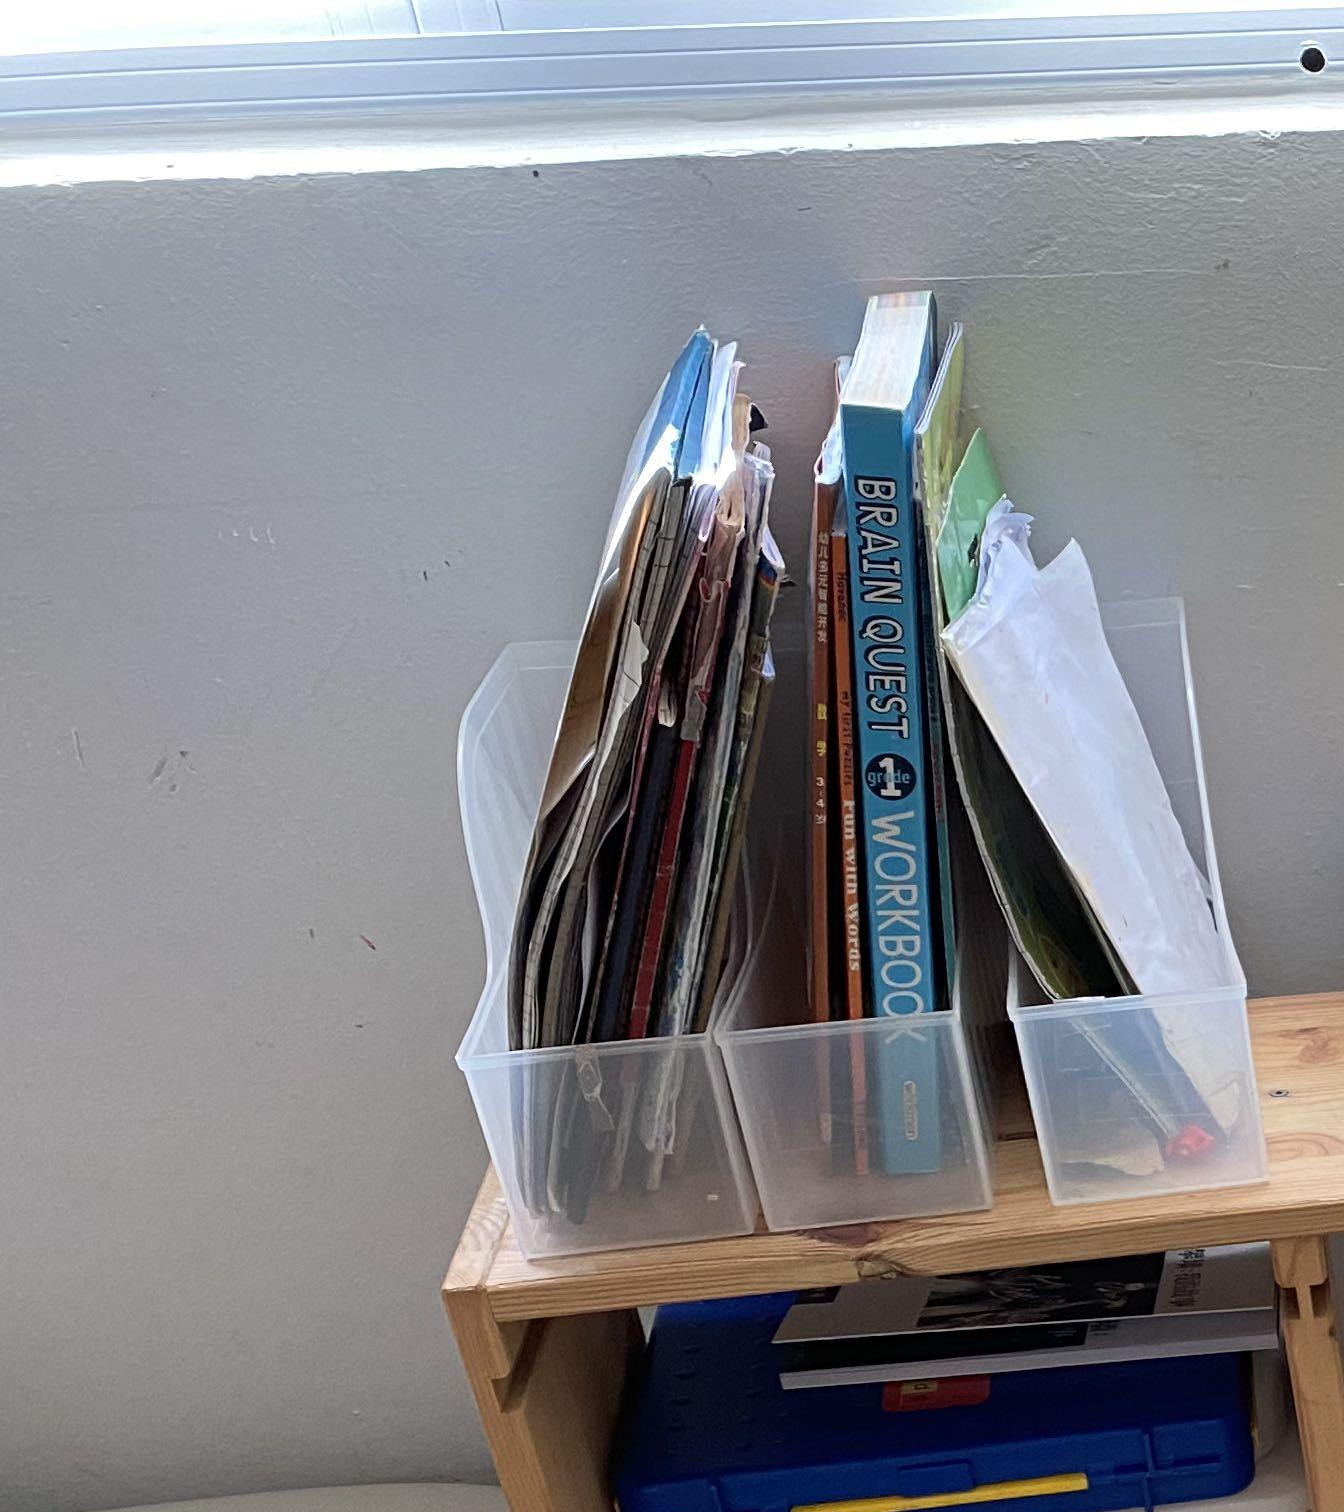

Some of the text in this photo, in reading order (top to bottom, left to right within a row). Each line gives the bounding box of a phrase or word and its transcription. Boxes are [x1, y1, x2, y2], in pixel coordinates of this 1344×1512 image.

[857, 476, 909, 739] BRAIN QUEST
[867, 757, 911, 798] grade 1
[843, 800, 860, 972] Fun with Words
[871, 810, 928, 1044] WORKBOOK
